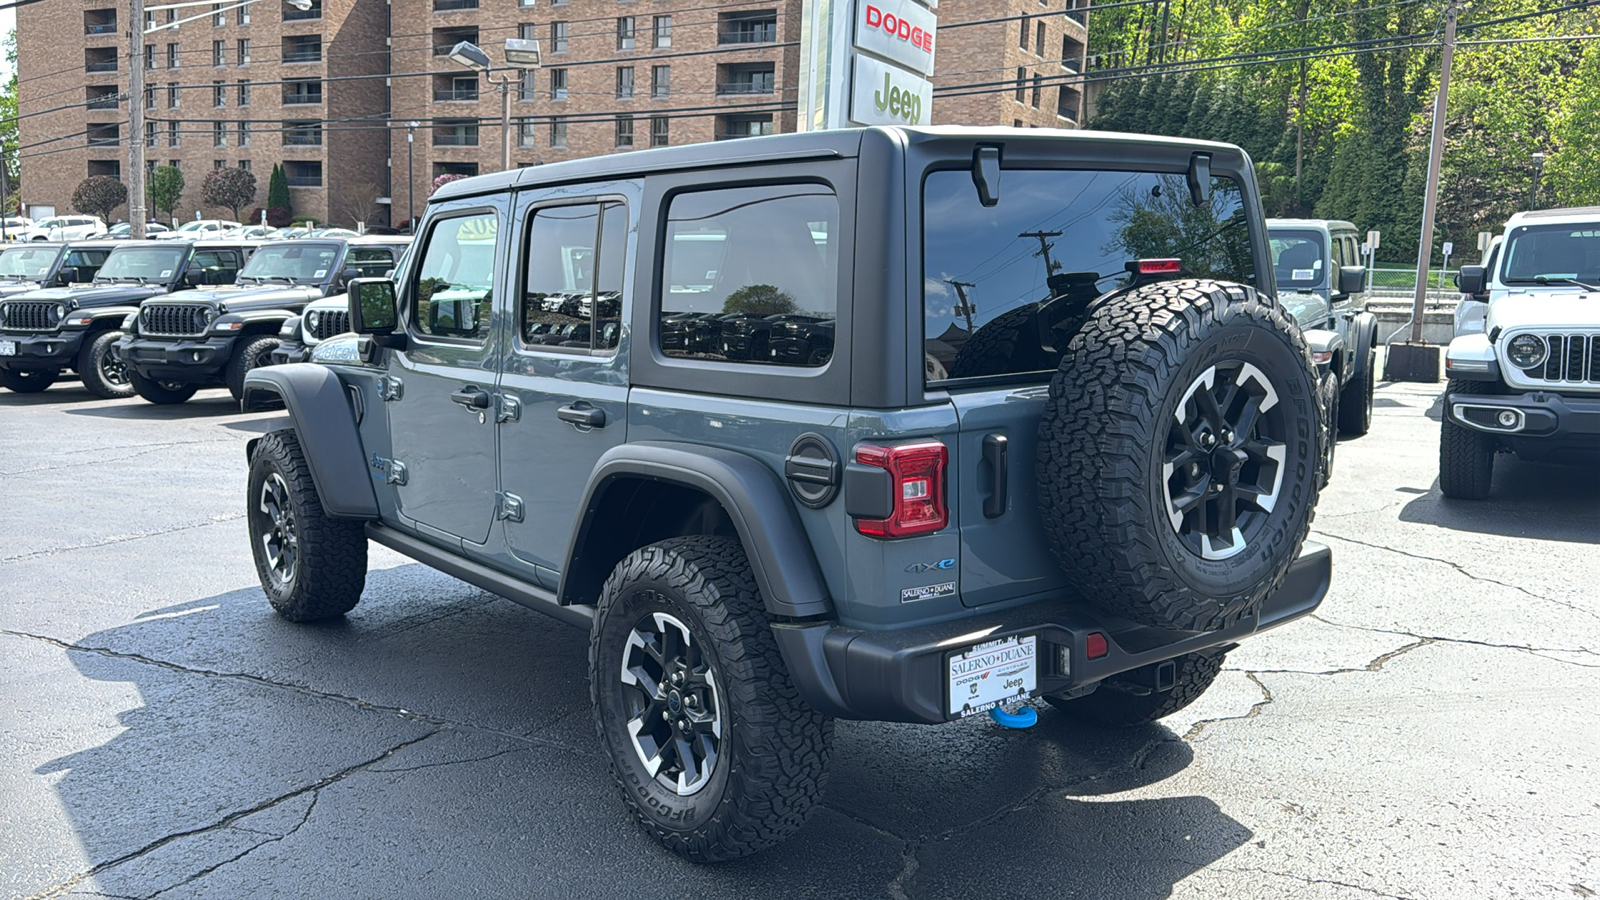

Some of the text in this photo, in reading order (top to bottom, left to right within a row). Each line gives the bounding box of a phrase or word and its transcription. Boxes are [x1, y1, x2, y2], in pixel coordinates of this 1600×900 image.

[866, 4, 933, 54] DODGE
[874, 71, 921, 126] Jeep
[903, 587, 929, 598] SALERNO
[935, 583, 954, 593] DUANE
[951, 644, 1034, 676] SALERNO DUANE
[1003, 677, 1024, 690] Jeep
[960, 691, 1031, 718] SALERNO DUANE
